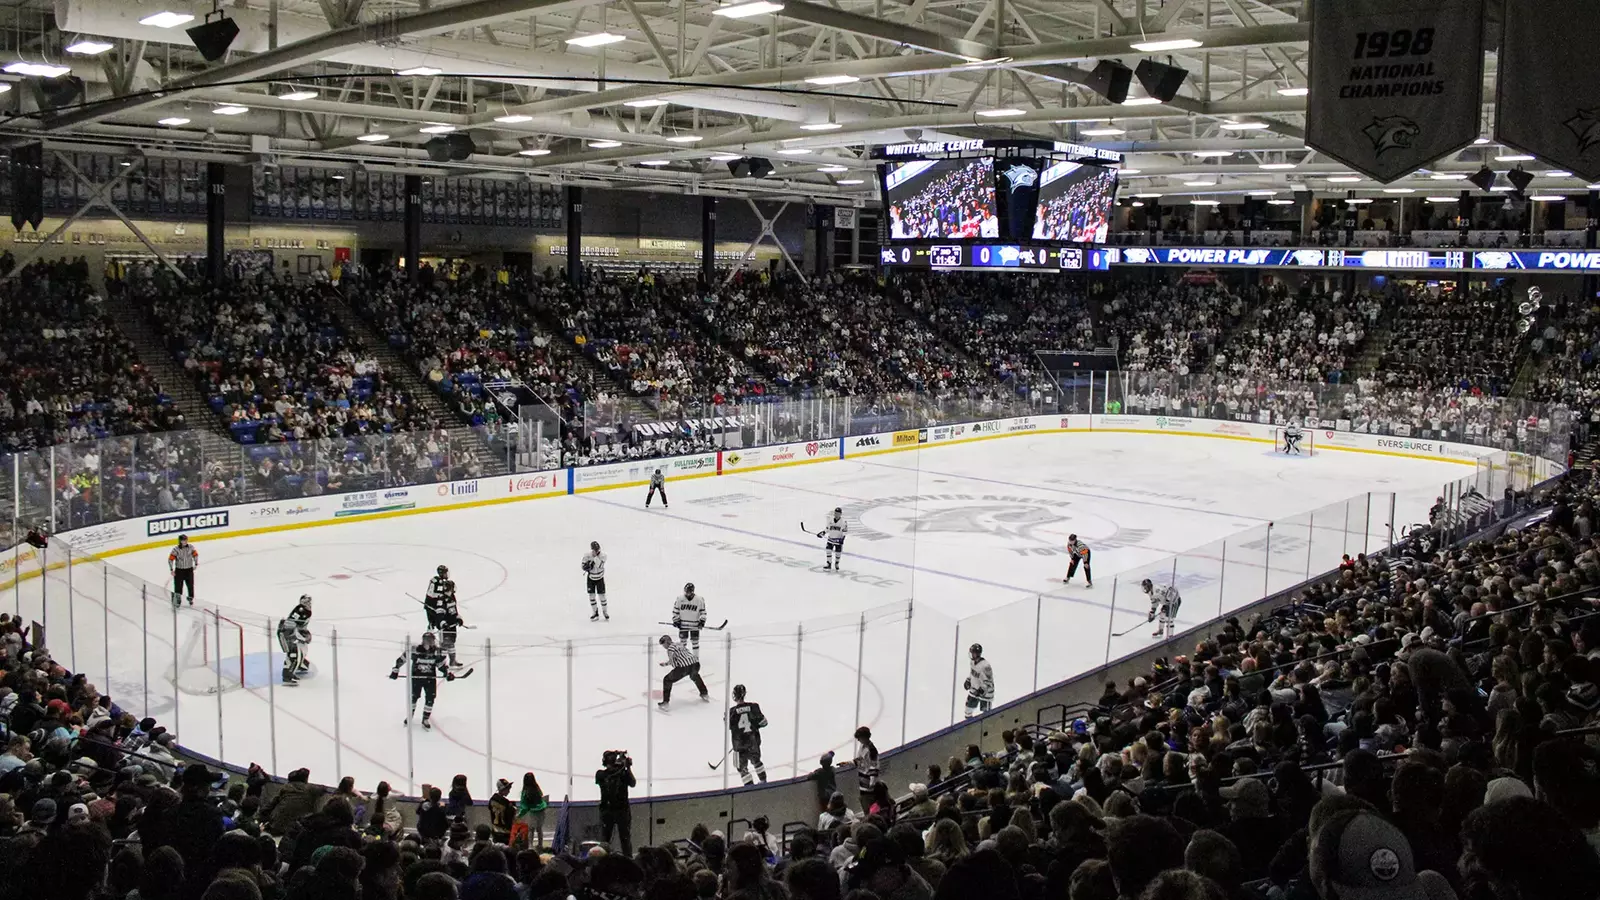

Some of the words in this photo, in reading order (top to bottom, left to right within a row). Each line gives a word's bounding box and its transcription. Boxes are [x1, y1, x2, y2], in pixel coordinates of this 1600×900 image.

[1354, 28, 1435, 60] 1998
[1350, 62, 1435, 80] NATIONAL
[1339, 80, 1444, 99] CHAMPIONS
[886, 142, 944, 155] WHITTEMORE
[947, 139, 984, 150] CENTER
[1054, 141, 1097, 158] WHITTEMORE
[1098, 148, 1120, 160] CENTER
[902, 248, 910, 262] 0
[980, 248, 990, 263] 0
[1040, 249, 1046, 264] 0
[1092, 252, 1100, 267] 0
[1168, 248, 1224, 263] POWER
[1228, 250, 1270, 264] PLAY
[982, 422, 1000, 432] HRCU
[1378, 439, 1432, 452] EVERSOURCE
[674, 459, 696, 468] SULLIVAN
[452, 480, 478, 496] Unitil
[516, 476, 548, 490] Coca-Cola
[260, 507, 280, 516] PSM
[149, 518, 182, 534] BUD
[182, 512, 228, 530] LIGHT
[738, 712, 752, 733] 4
